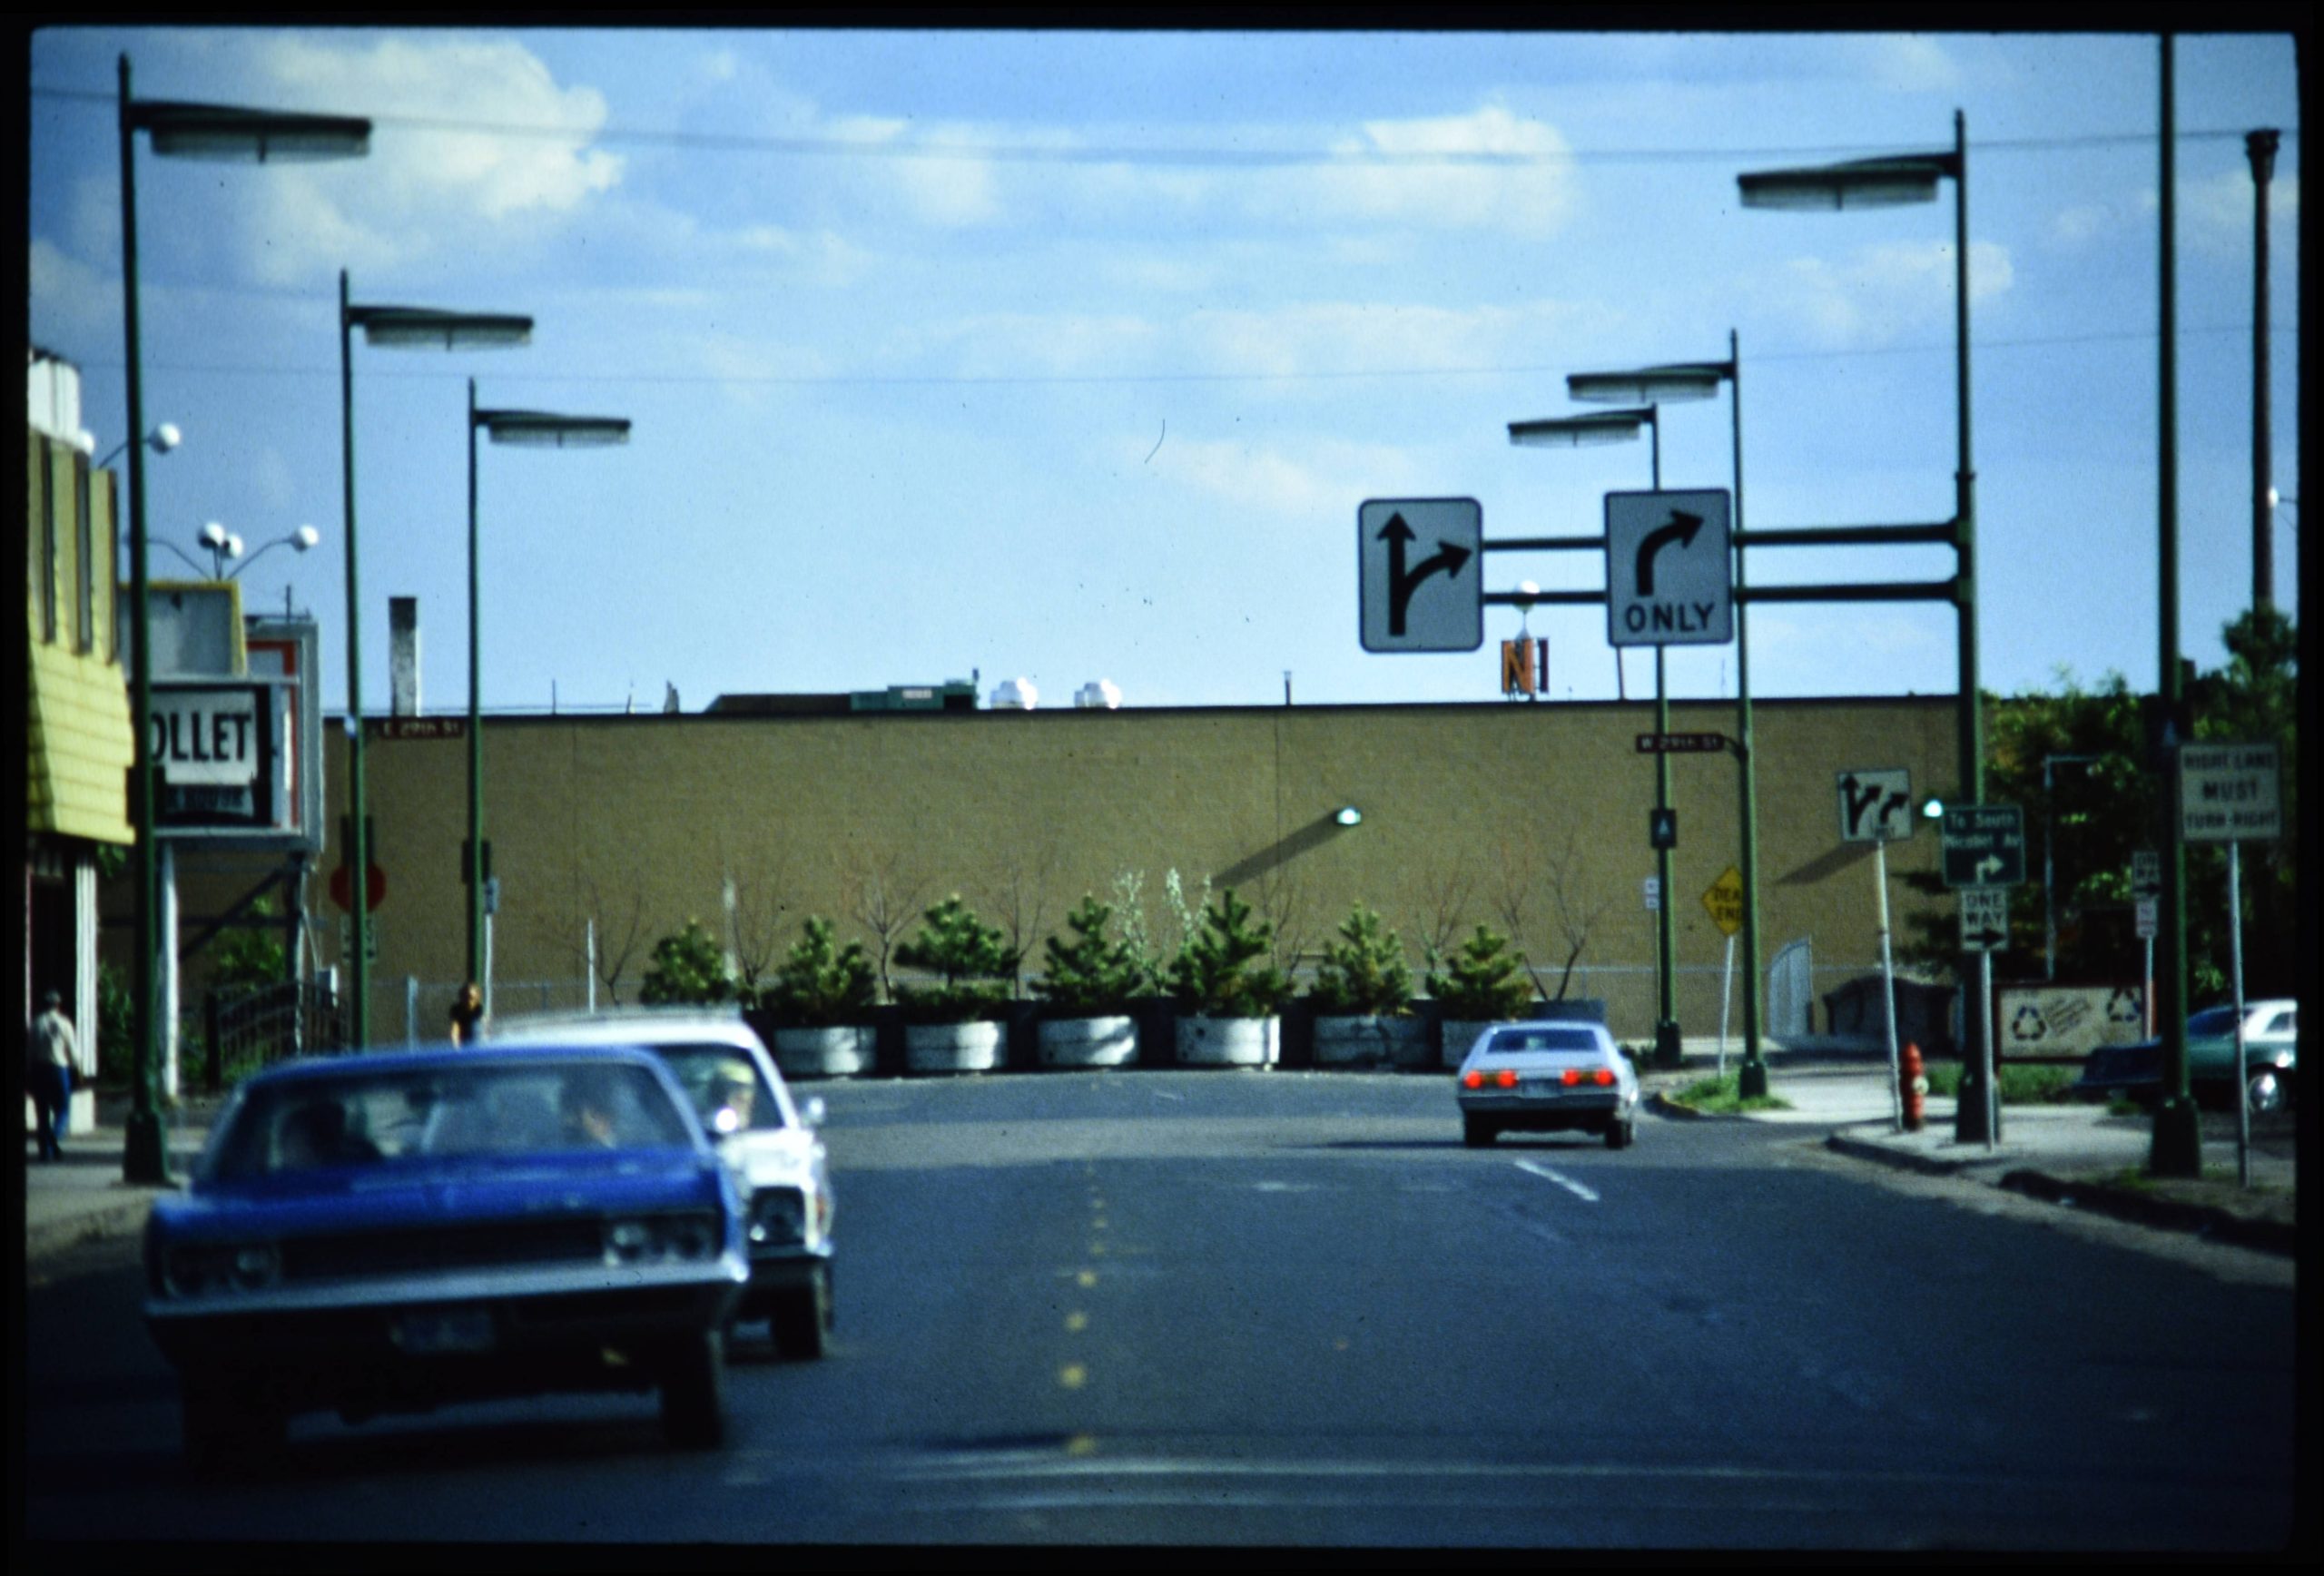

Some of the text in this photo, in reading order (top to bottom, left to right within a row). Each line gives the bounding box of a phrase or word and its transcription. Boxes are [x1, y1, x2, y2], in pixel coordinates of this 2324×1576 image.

[1624, 602, 1715, 634] ONLY
[1641, 735, 1654, 749] W
[2184, 752, 2278, 769] RIGHT LANE
[2202, 780, 2257, 802] MUST
[1949, 811, 2016, 828] To South
[2184, 810, 2277, 828] TURN RIGHT
[1714, 886, 1742, 901] DEA
[1966, 893, 2002, 908] ONE
[1966, 911, 2003, 925] WAY
